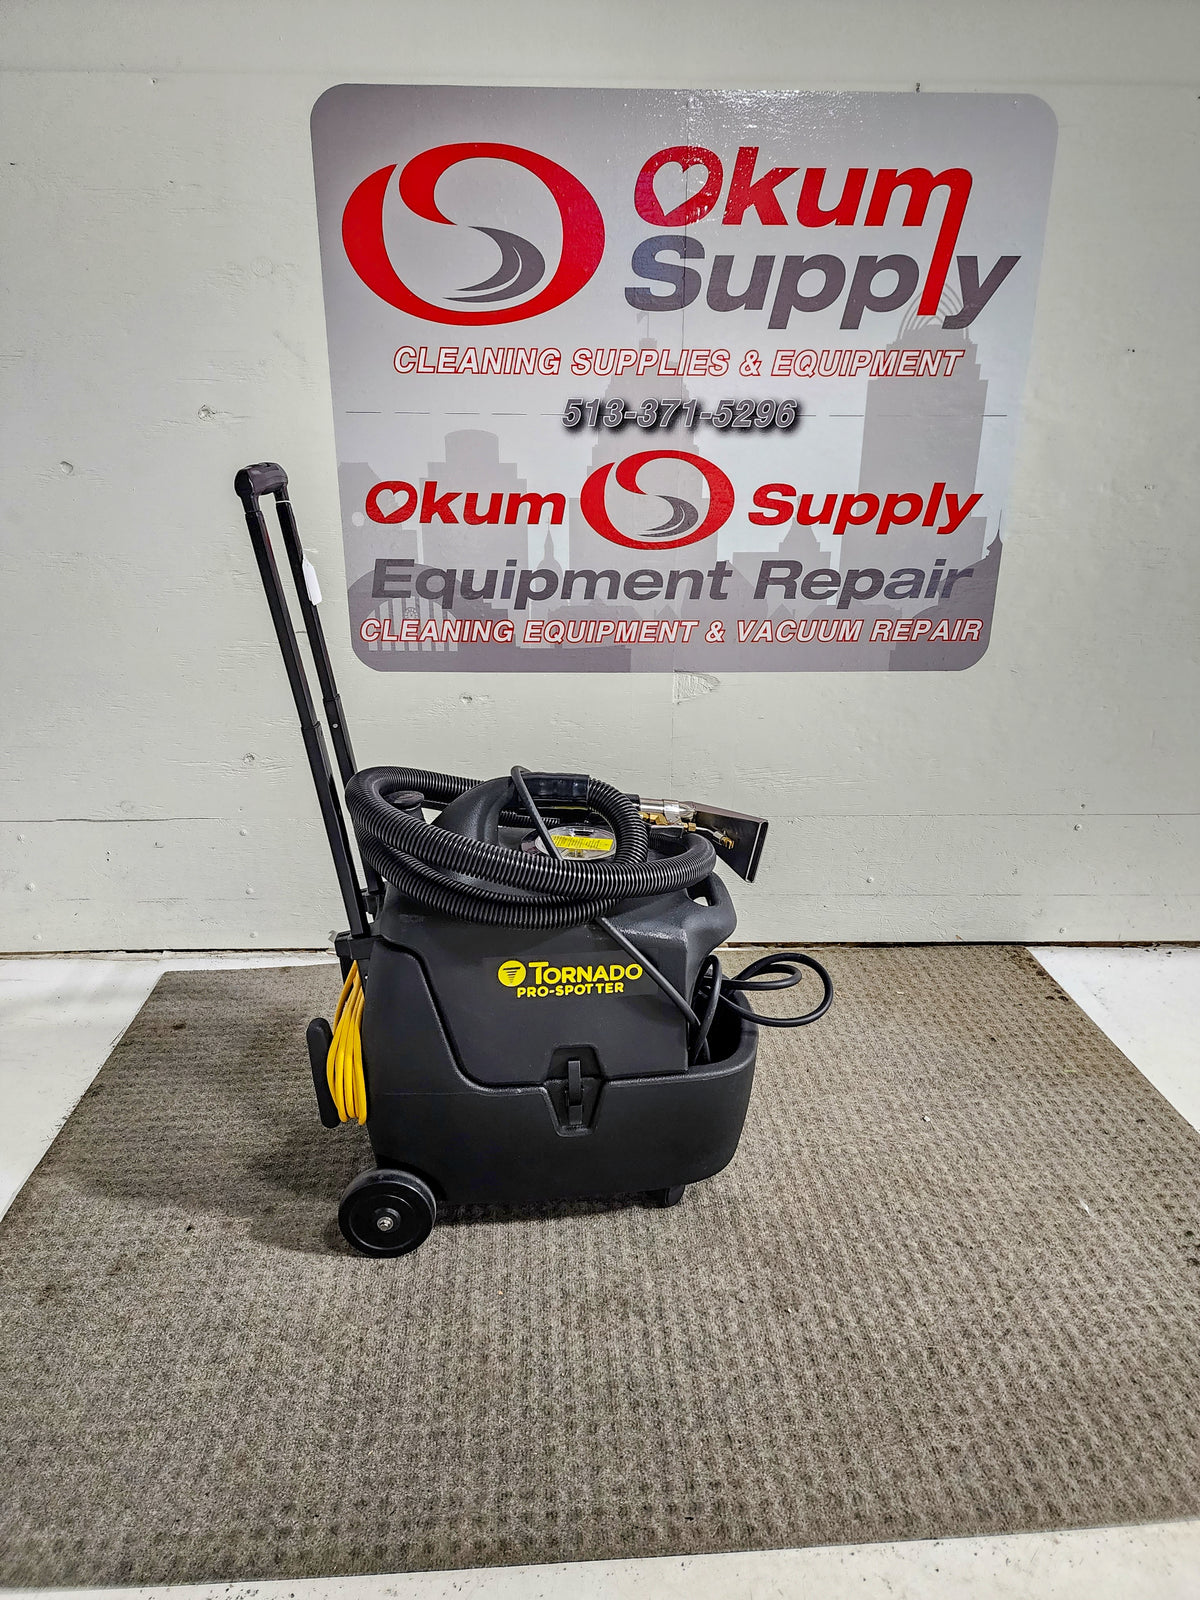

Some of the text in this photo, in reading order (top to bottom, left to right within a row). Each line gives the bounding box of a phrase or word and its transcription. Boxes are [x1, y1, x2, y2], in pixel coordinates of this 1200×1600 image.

[634, 145, 973, 228] Okum
[624, 235, 1021, 330] Supply
[393, 346, 966, 378] CLEANING SUPPLIES & EQUIPMENT
[562, 398, 797, 429] 513-371-5296
[365, 480, 983, 535] Okum Supply
[371, 558, 975, 610] Equipment Repair
[360, 618, 983, 644] CLEANING EQUIPMENT & VACUUM REPAIR
[516, 983, 625, 998] PRO-SPOTTER
